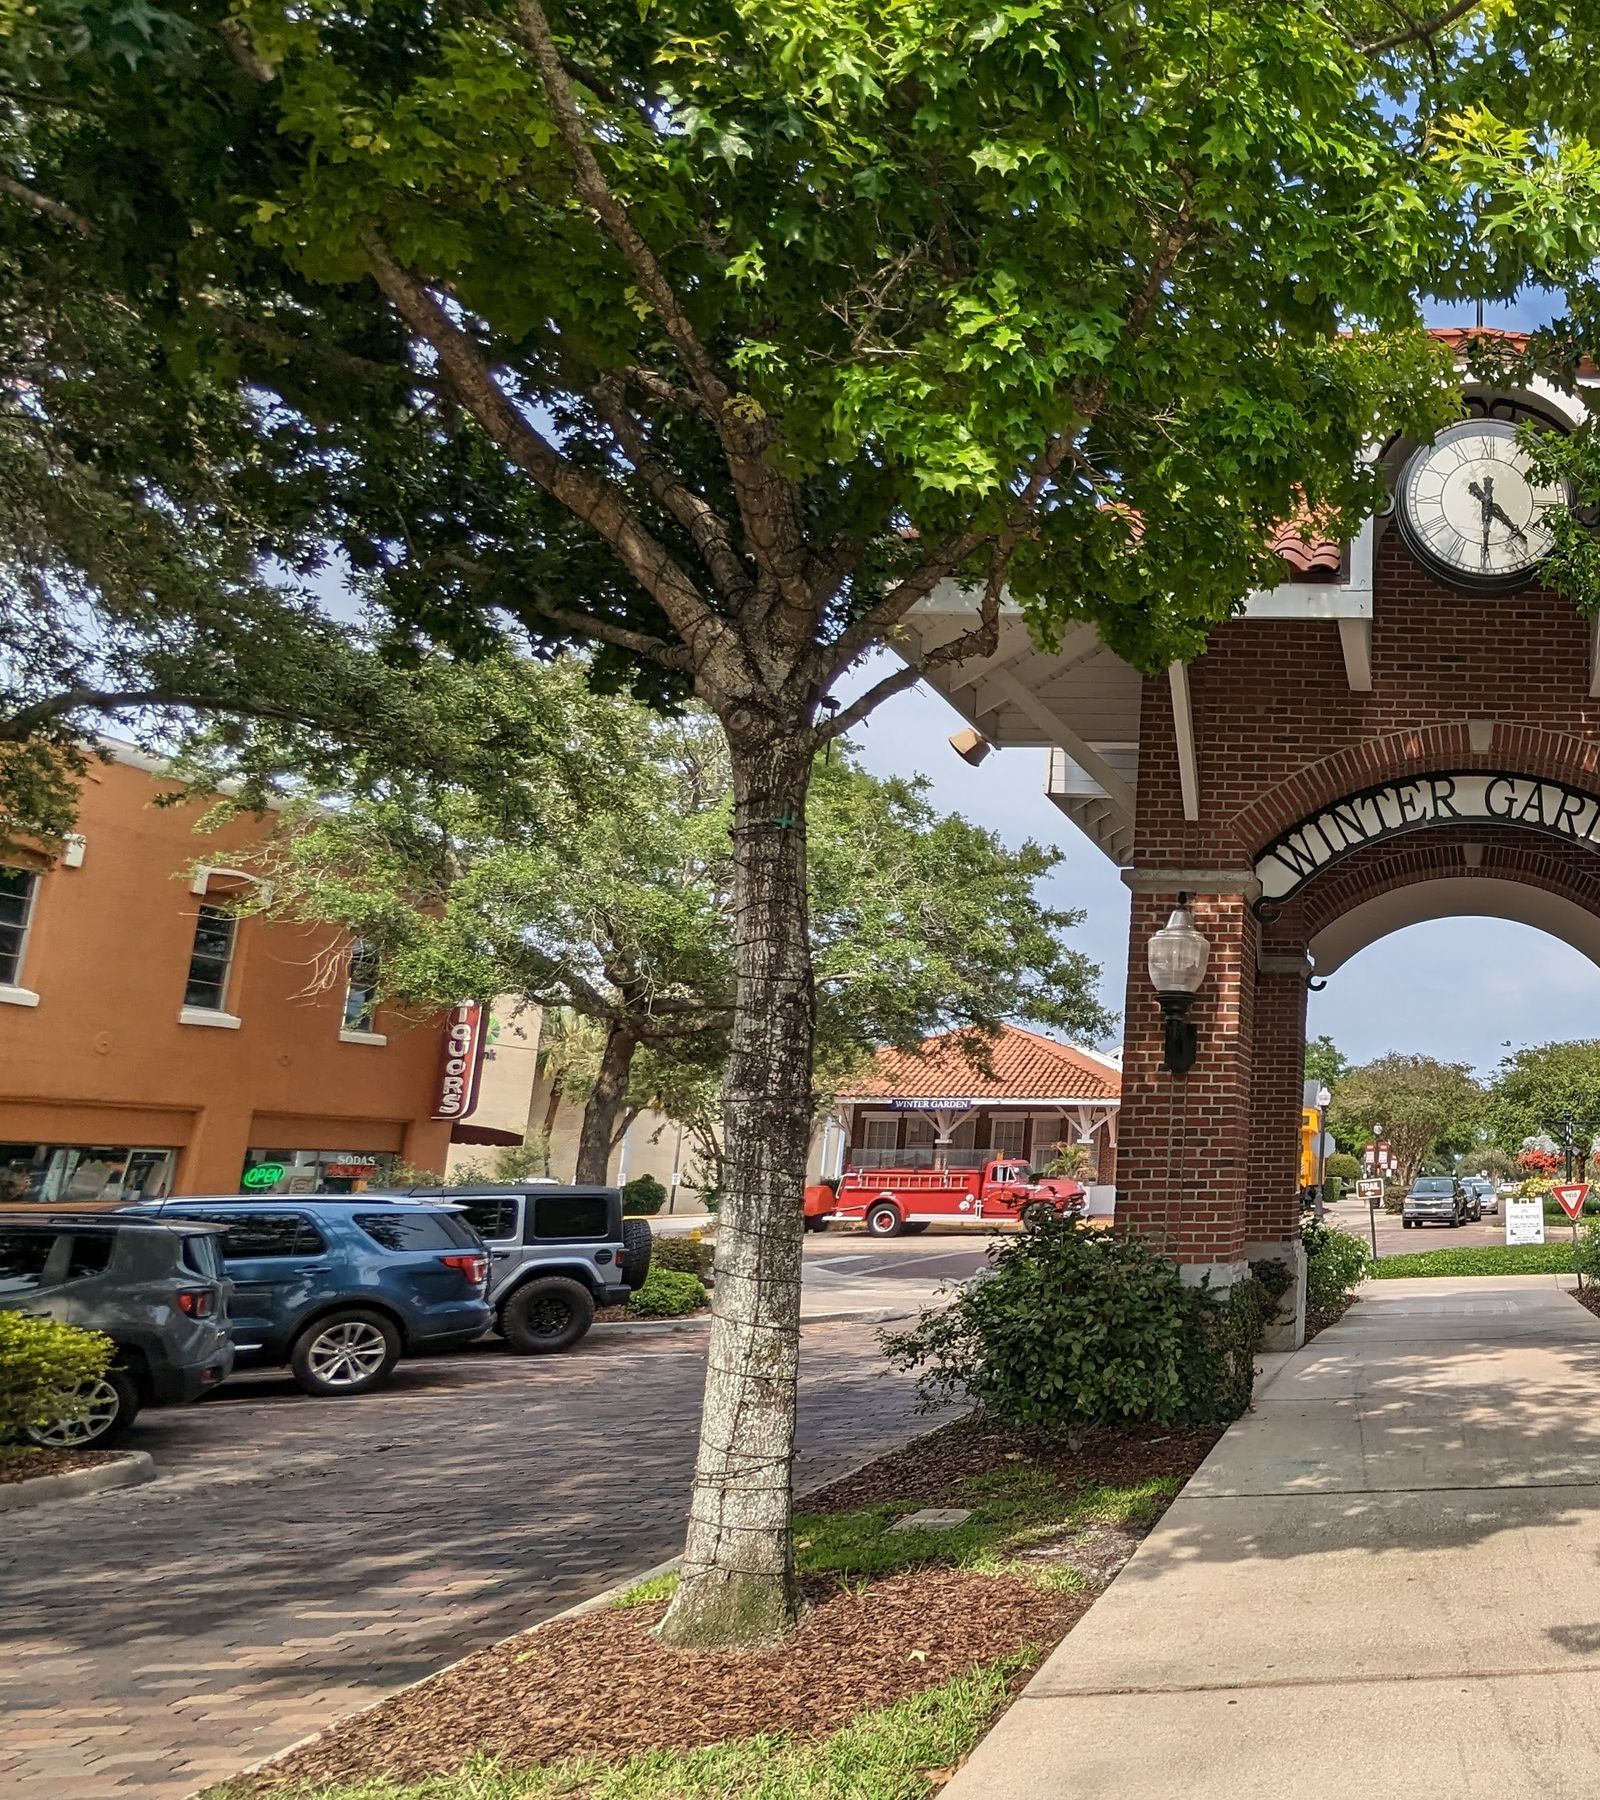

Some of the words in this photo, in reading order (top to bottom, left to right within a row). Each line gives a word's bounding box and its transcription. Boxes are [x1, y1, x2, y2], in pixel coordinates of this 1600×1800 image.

[1270, 777, 1463, 880] WINTER
[438, 1000, 475, 1114] IQUORS
[895, 1100, 930, 1108] WINTER
[930, 1100, 968, 1108] GARDEN
[337, 1155, 376, 1166] SODAS
[246, 1167, 283, 1184] OPEN
[1360, 1182, 1381, 1192] TRAIL
